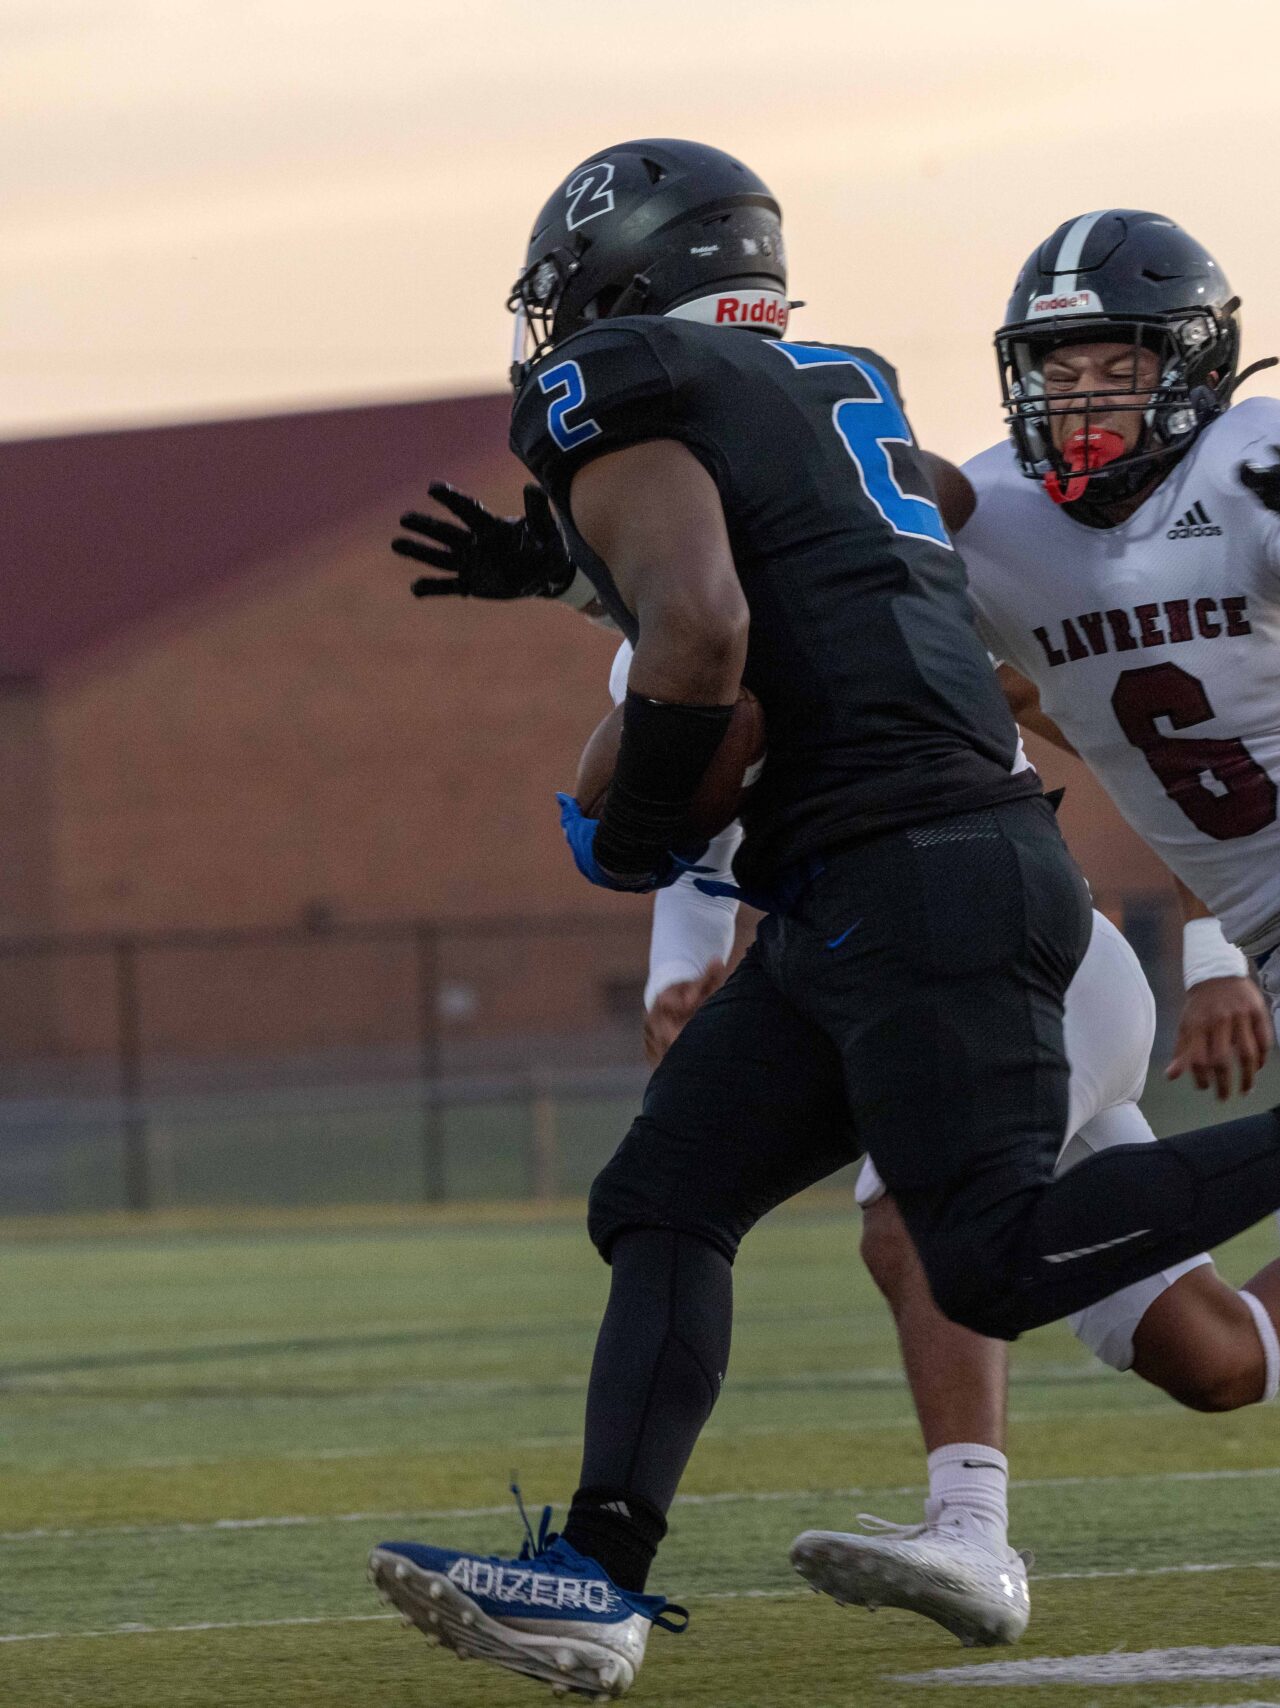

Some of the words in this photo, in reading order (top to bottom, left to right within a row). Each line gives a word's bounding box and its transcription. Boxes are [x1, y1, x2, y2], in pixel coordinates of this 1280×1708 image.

[565, 163, 615, 231] 2
[715, 298, 788, 327] Ridde
[538, 360, 602, 451] 2
[762, 340, 955, 551] 2
[1167, 526, 1223, 540] adidas
[1033, 596, 1252, 667] LAWRENCE
[1111, 661, 1278, 841] 6
[447, 1557, 622, 1614] ADIZERO
